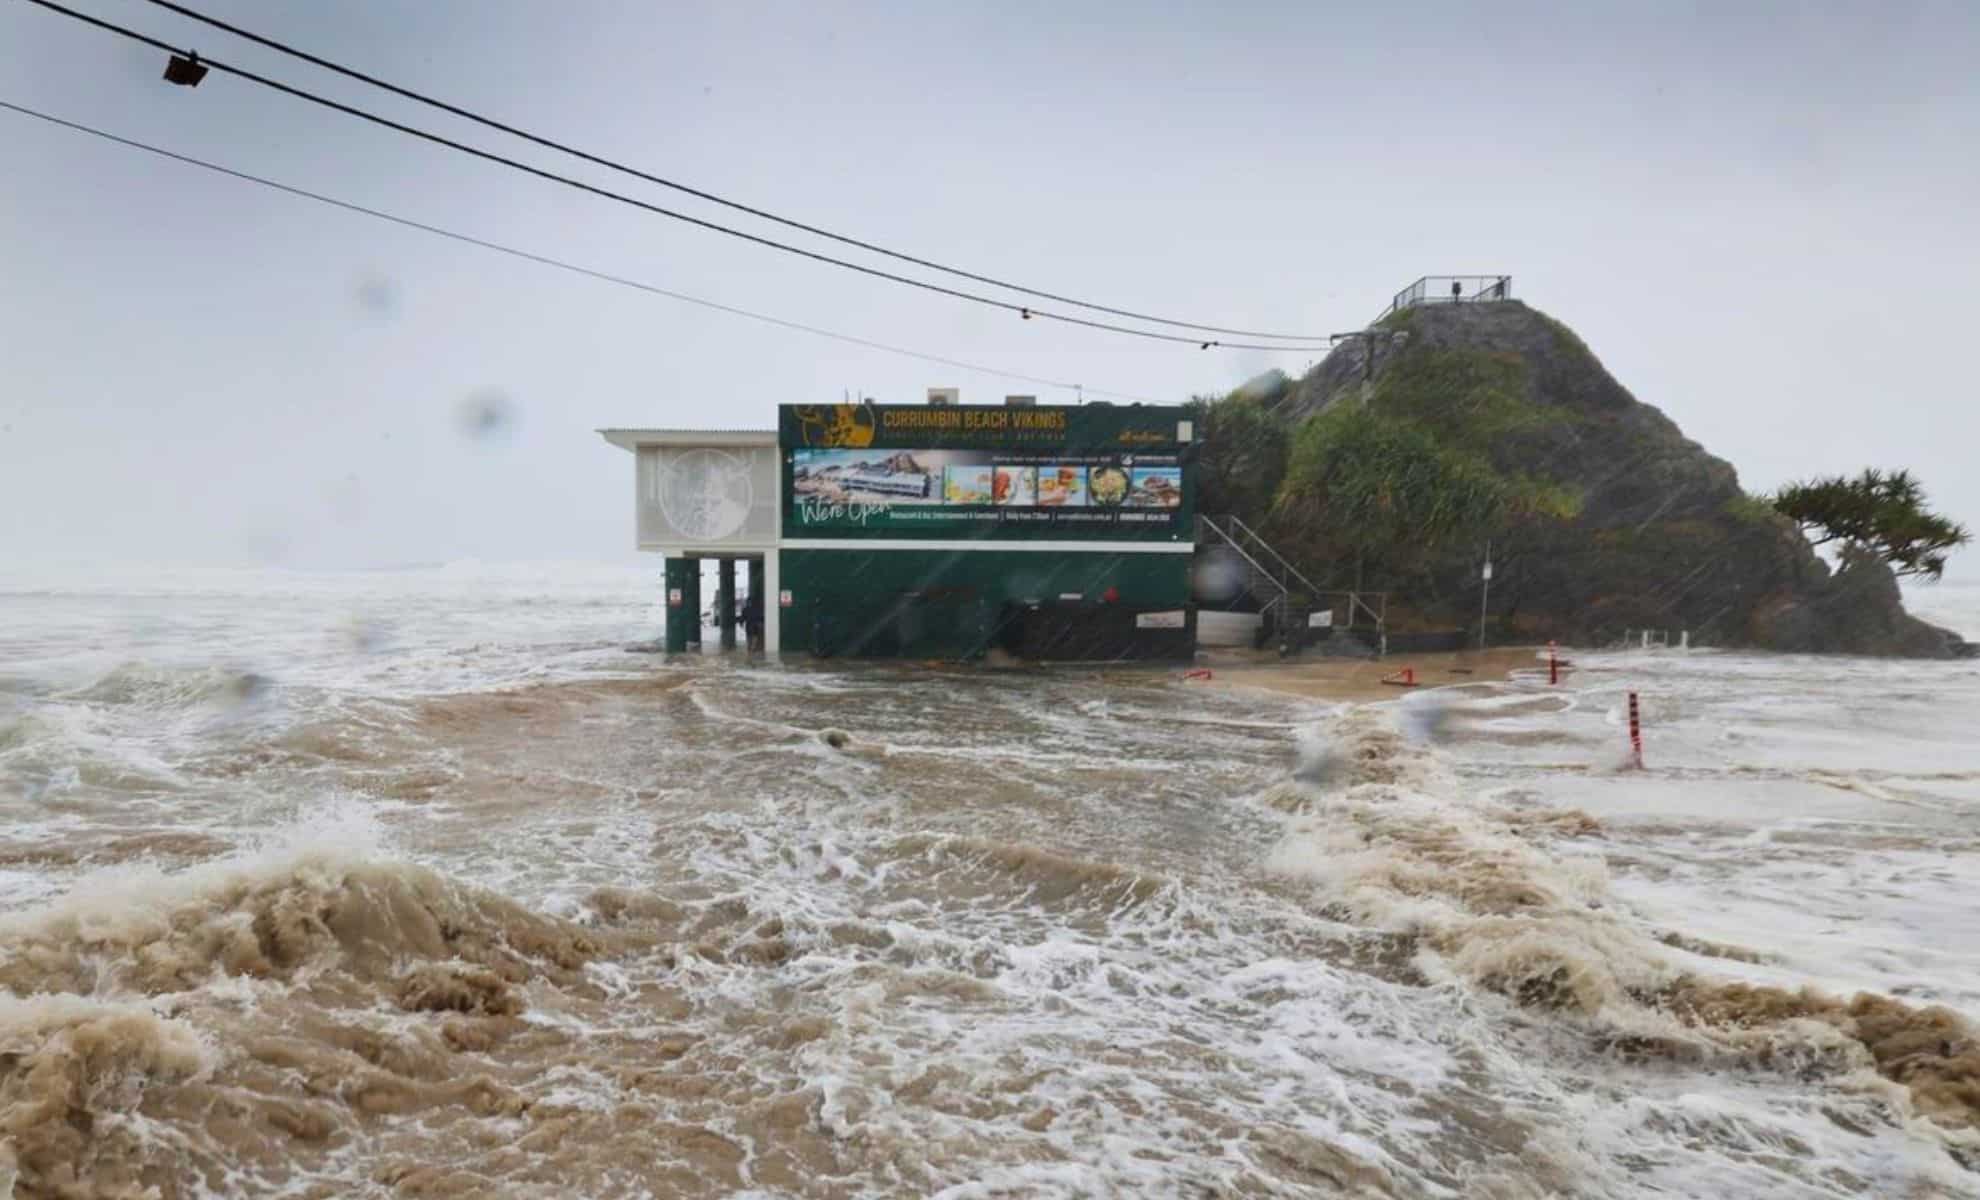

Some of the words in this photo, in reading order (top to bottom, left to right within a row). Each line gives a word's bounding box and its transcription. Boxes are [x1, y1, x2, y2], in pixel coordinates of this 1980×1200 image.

[883, 411, 961, 427] CURRUMBIN
[965, 411, 1008, 427] BEACH
[1012, 411, 1065, 428] VIKINGS
[847, 498, 891, 526] Open
